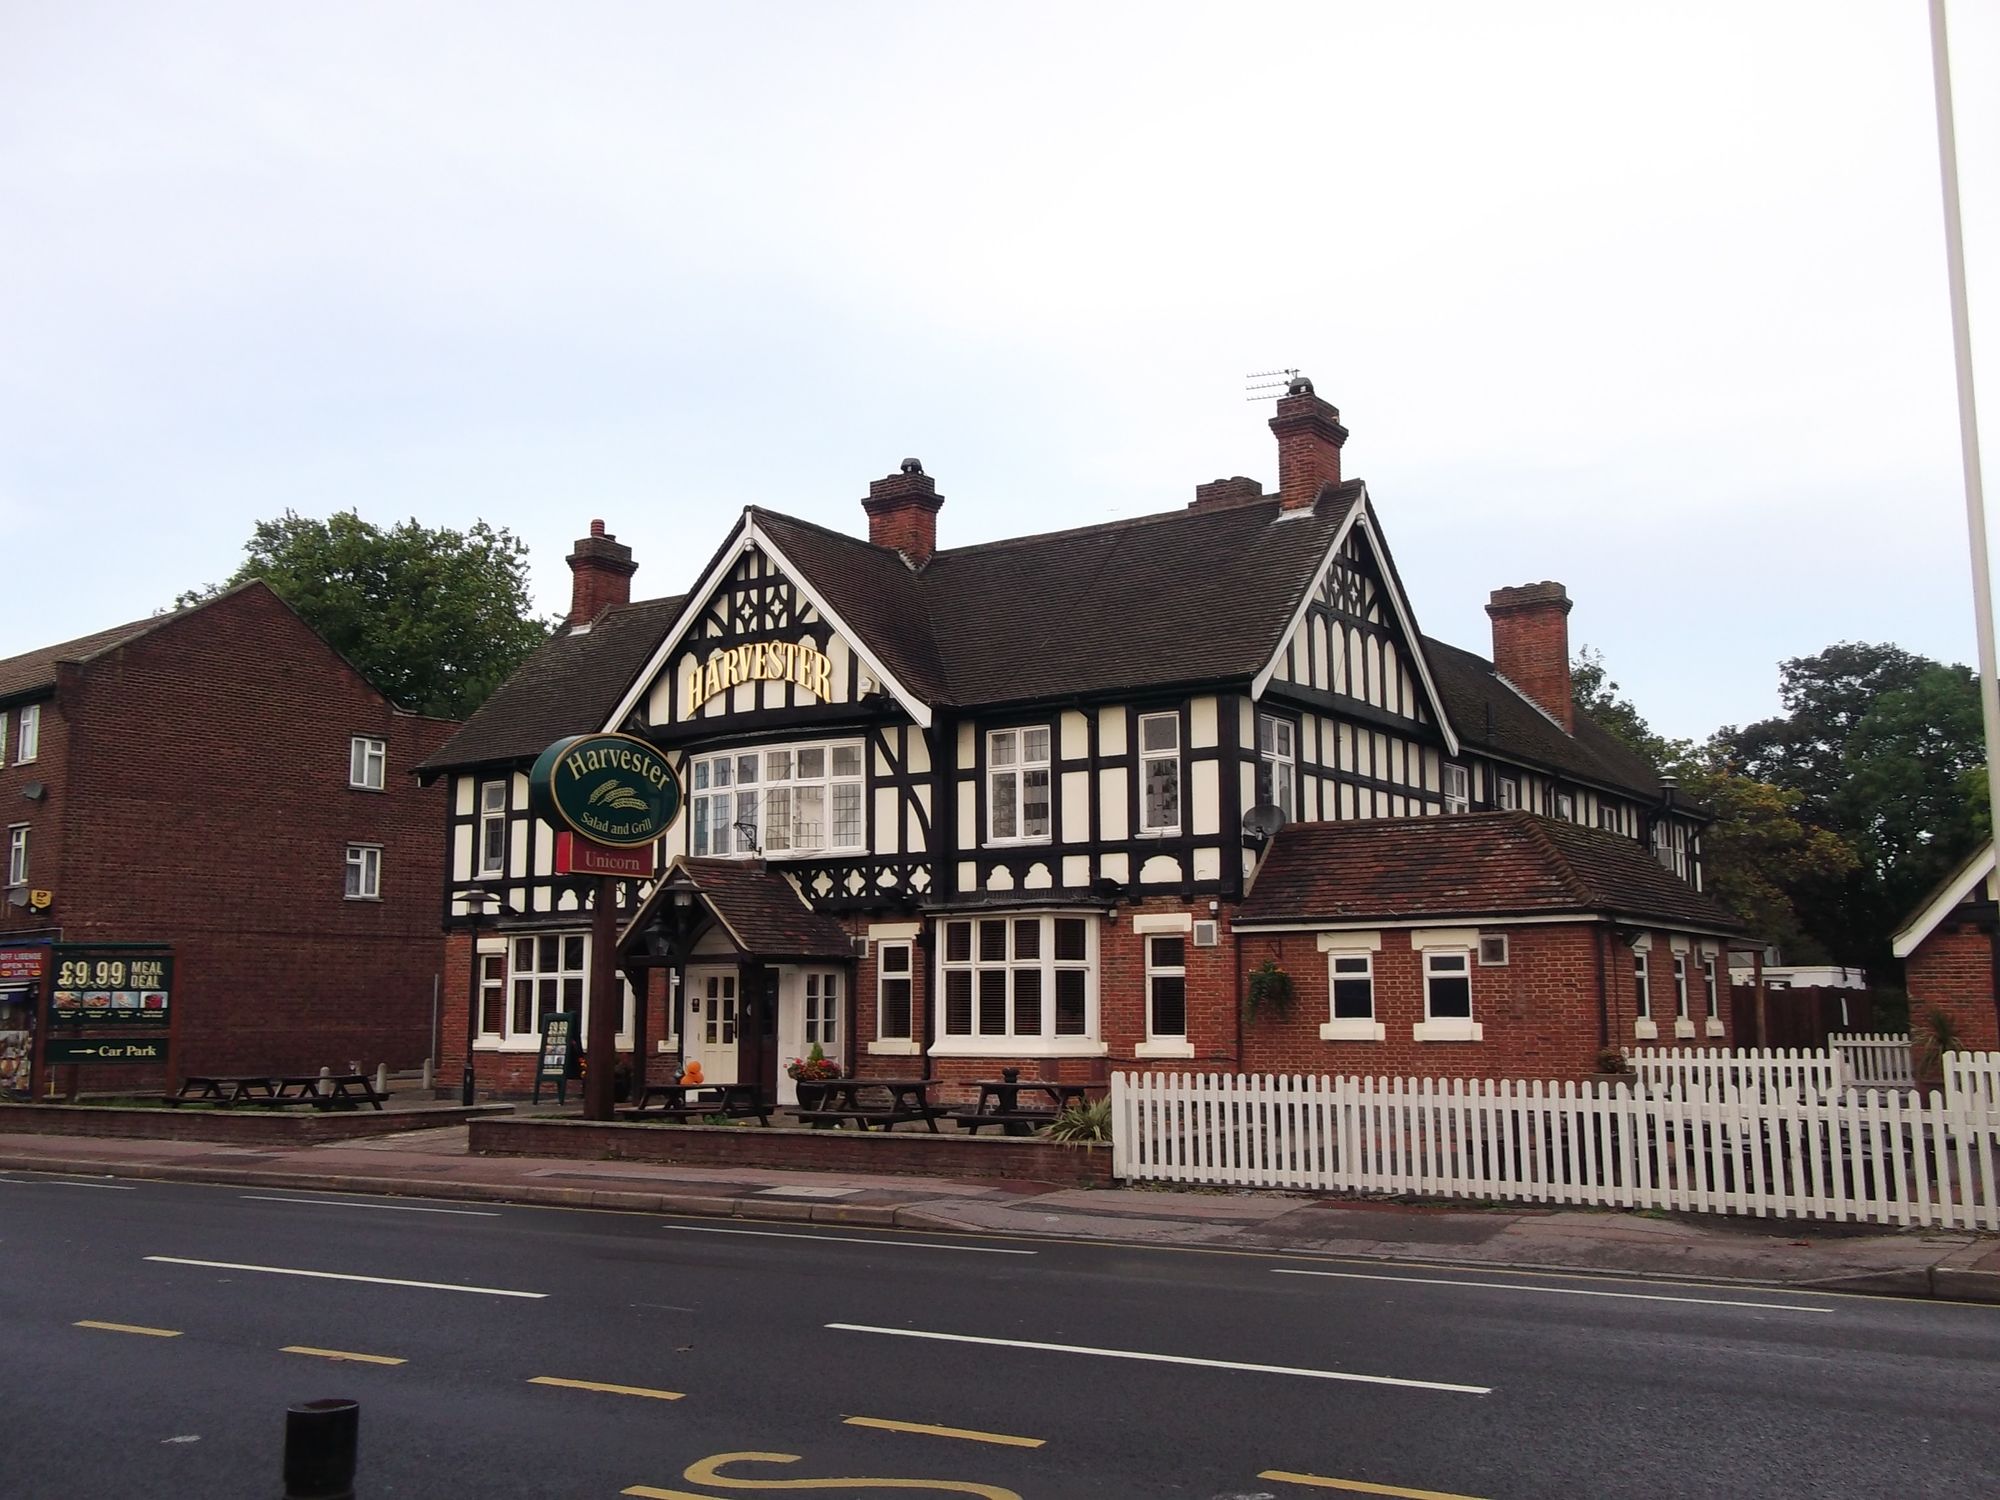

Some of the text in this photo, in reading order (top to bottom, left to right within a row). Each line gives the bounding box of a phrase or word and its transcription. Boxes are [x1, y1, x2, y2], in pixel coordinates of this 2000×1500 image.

[687, 642, 832, 719] HARVESTER
[566, 748, 670, 791] Harvester
[581, 811, 652, 835] Salad and Grill
[585, 851, 640, 870] Unicorn
[58, 961, 125, 988] £9.99
[131, 961, 163, 975] MEAL
[130, 975, 161, 988] DEAL
[98, 1045, 157, 1057] Car Park
